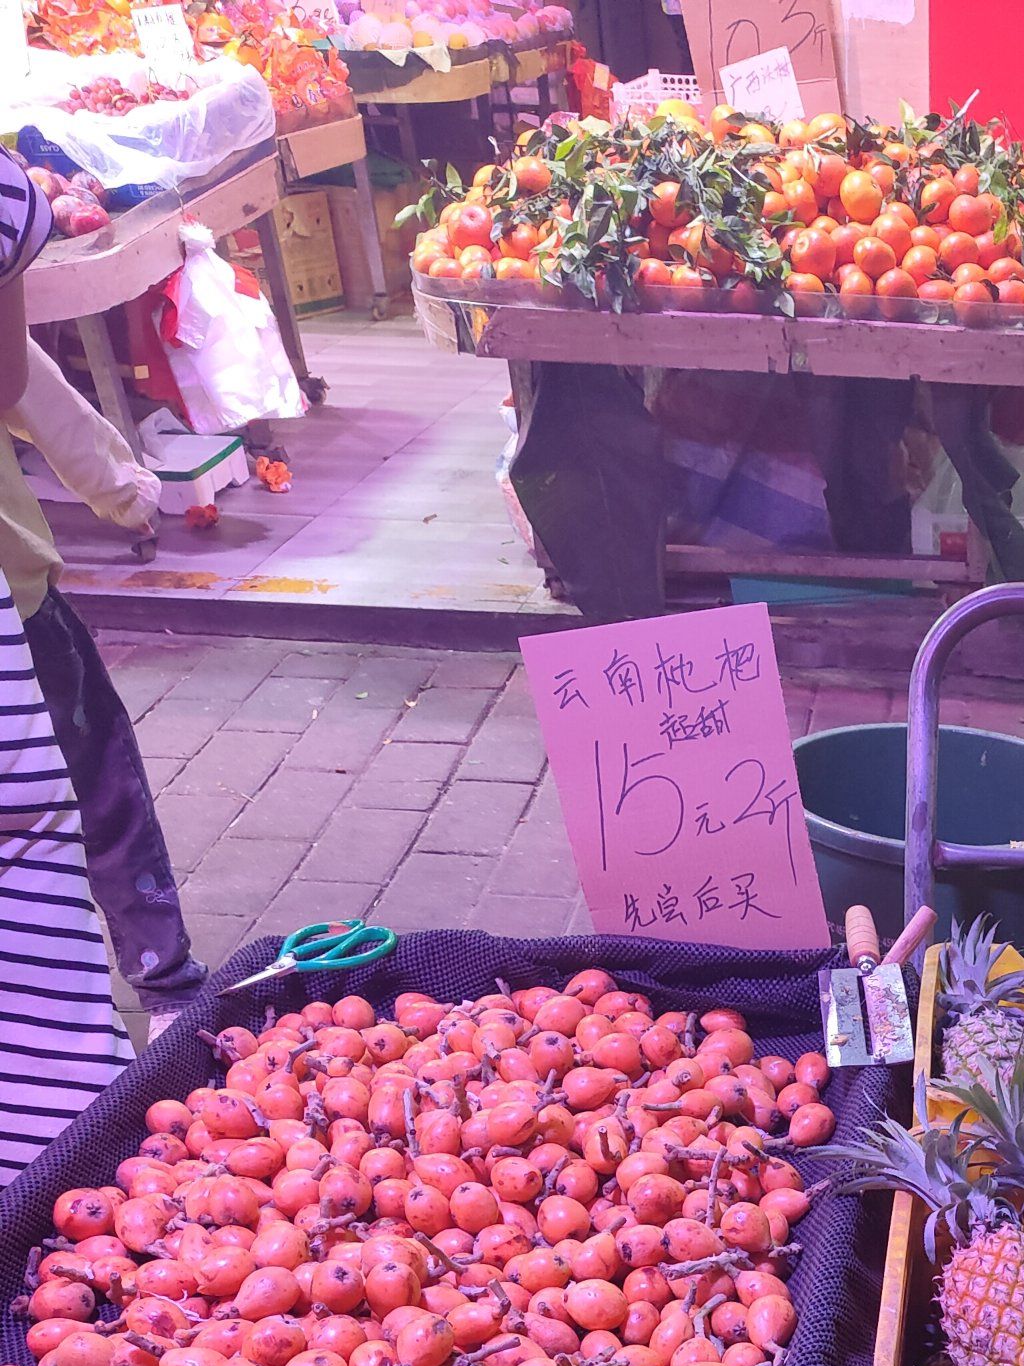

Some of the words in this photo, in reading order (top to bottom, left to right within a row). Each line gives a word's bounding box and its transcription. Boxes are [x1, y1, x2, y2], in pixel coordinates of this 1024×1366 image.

[553, 637, 761, 710] 云南枇杷
[659, 699, 731, 750] 超甜
[623, 872, 783, 933] 先尝后买
